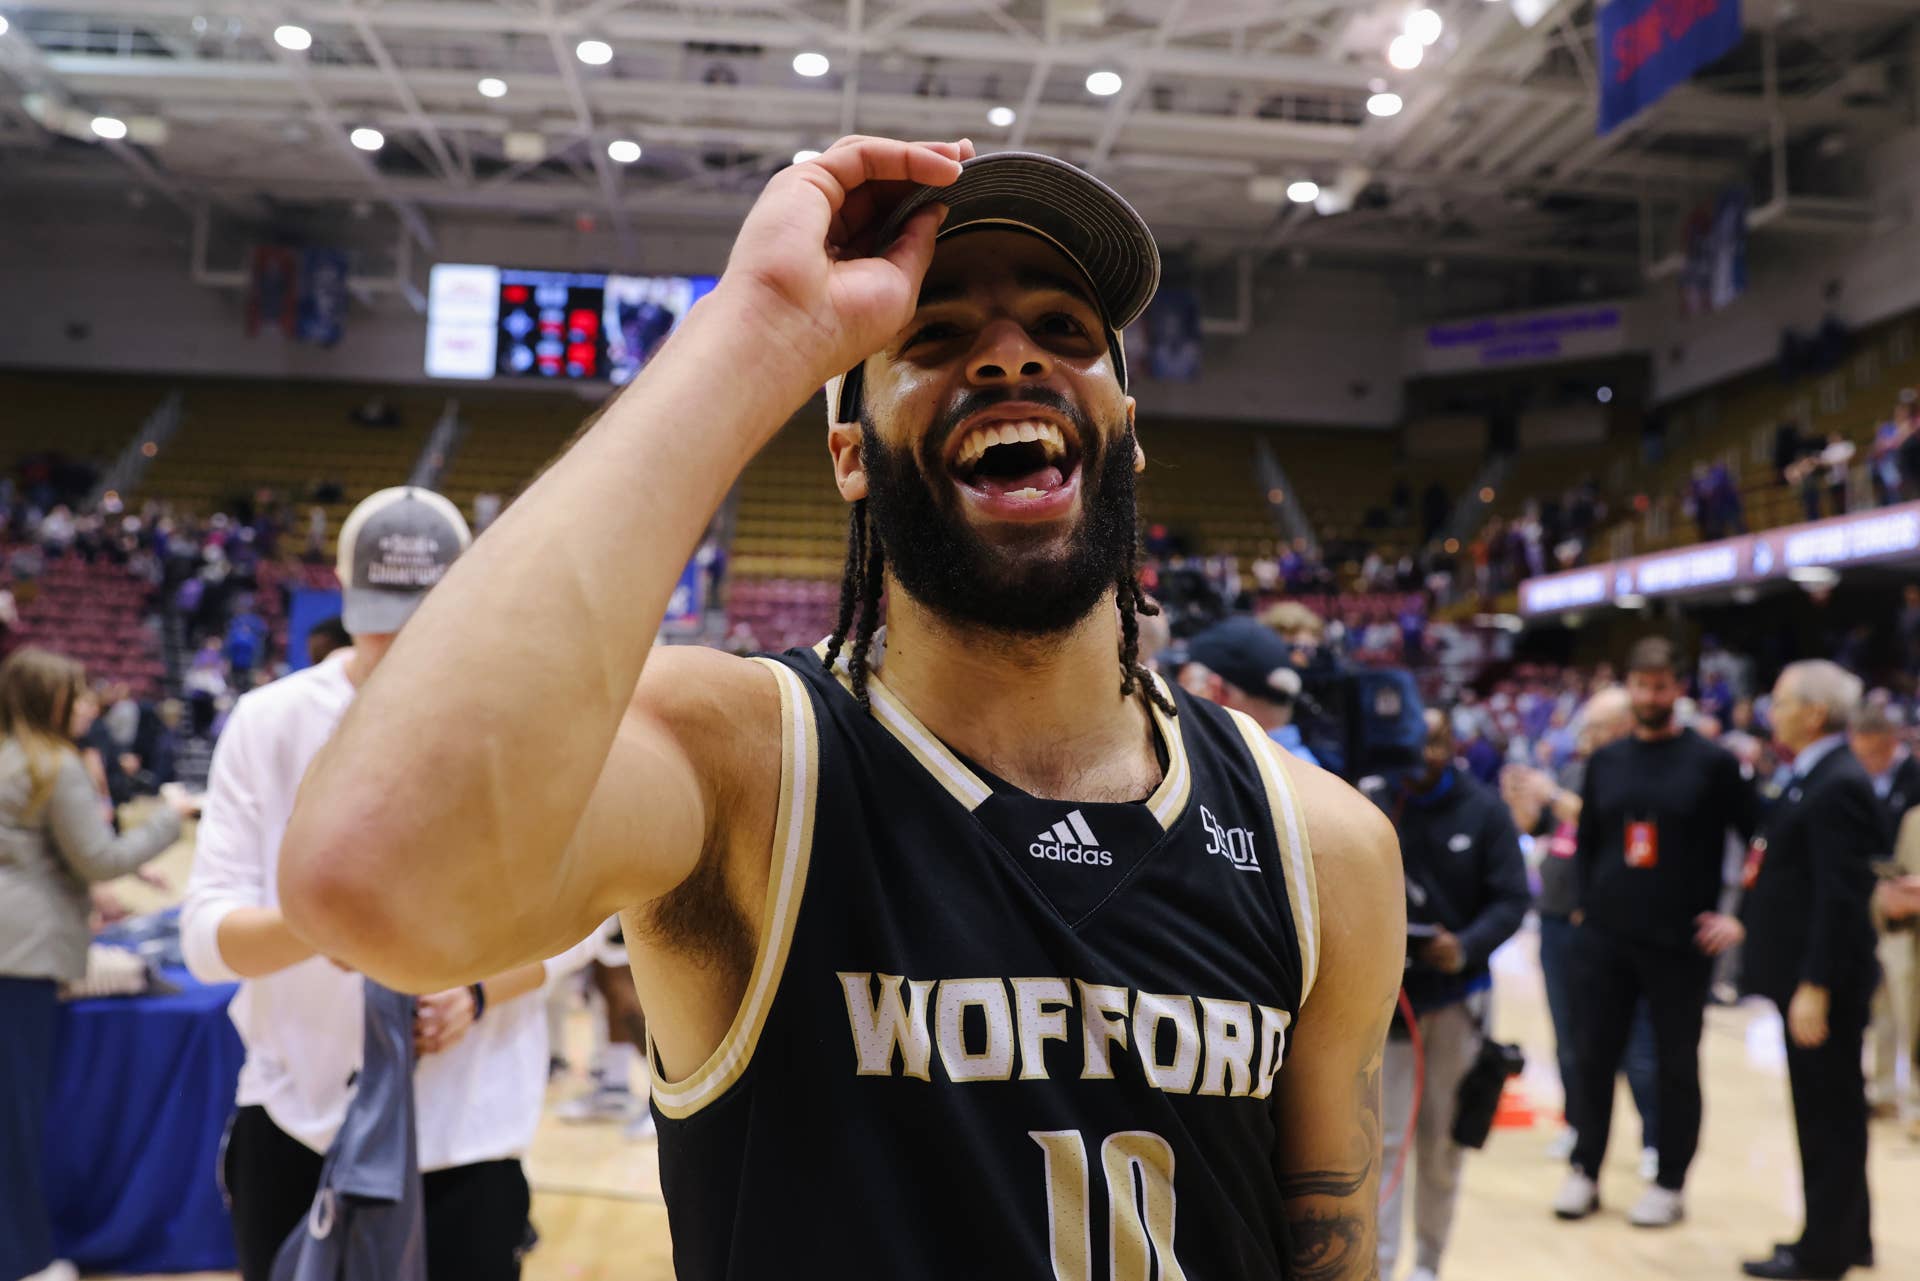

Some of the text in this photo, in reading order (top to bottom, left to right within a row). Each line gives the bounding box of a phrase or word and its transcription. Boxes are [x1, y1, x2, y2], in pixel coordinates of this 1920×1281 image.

[1029, 841, 1113, 866] adidas
[836, 971, 1291, 1100] WOFFORD
[1028, 1129, 1188, 1281] 10
